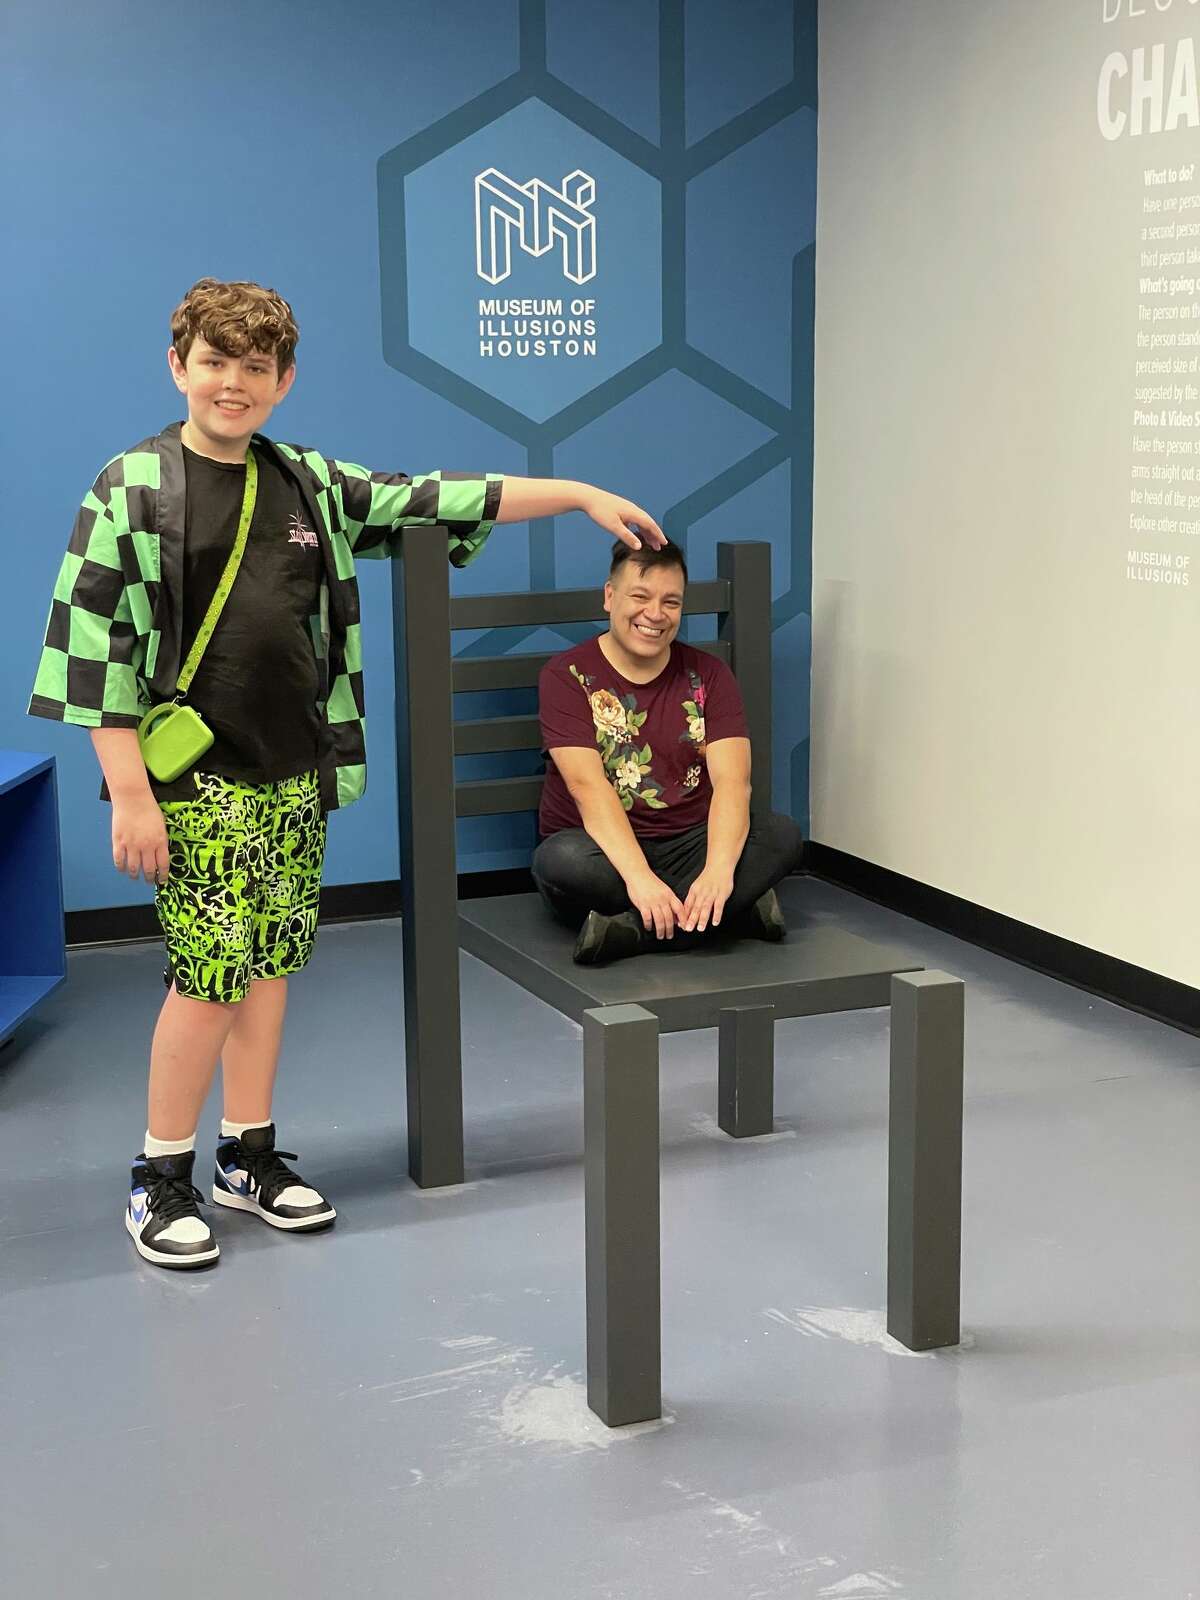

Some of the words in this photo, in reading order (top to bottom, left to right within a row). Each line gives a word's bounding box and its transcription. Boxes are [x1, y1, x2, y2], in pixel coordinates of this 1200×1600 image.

[1144, 168, 1166, 185] What
[1168, 168, 1177, 183] to
[1179, 164, 1195, 181] do?
[1143, 197, 1161, 213] Have
[1163, 198, 1177, 211] one
[1148, 221, 1175, 240] second
[1140, 249, 1158, 267] third
[1159, 251, 1185, 269] person
[1139, 276, 1168, 294] What's
[1169, 275, 1195, 296] going
[478, 299, 563, 316] MUSEUM
[570, 299, 596, 316] OF
[1138, 304, 1152, 321] The
[1152, 306, 1178, 323] person
[1180, 305, 1190, 320] on
[479, 319, 596, 337] ILLUSIONS
[479, 339, 597, 357] HOUSTON
[1137, 331, 1150, 347] the
[1150, 334, 1176, 350] person
[1135, 357, 1171, 377] perceived
[1173, 357, 1188, 373] size
[1189, 356, 1198, 373] of
[1135, 384, 1172, 404] suggested
[1174, 384, 1183, 405] by
[1185, 384, 1198, 400] the
[1134, 410, 1159, 426] Photo
[1160, 410, 1167, 426] &
[1168, 410, 1193, 427] Video
[1132, 435, 1151, 453] Have
[1152, 437, 1165, 453] the
[1166, 440, 1192, 457] person
[1131, 465, 1150, 479] arms
[1151, 464, 1180, 484] straight
[1181, 466, 1195, 481] out
[1130, 488, 1143, 504] the
[1144, 488, 1163, 505] head
[1165, 490, 1174, 506] of
[1174, 491, 1187, 507] the
[1129, 512, 1156, 533] Explore
[1157, 513, 1178, 533] other
[1127, 550, 1172, 568] MUSEUM
[1175, 555, 1190, 569] OF
[1126, 566, 1190, 586] ILLUSIONS
